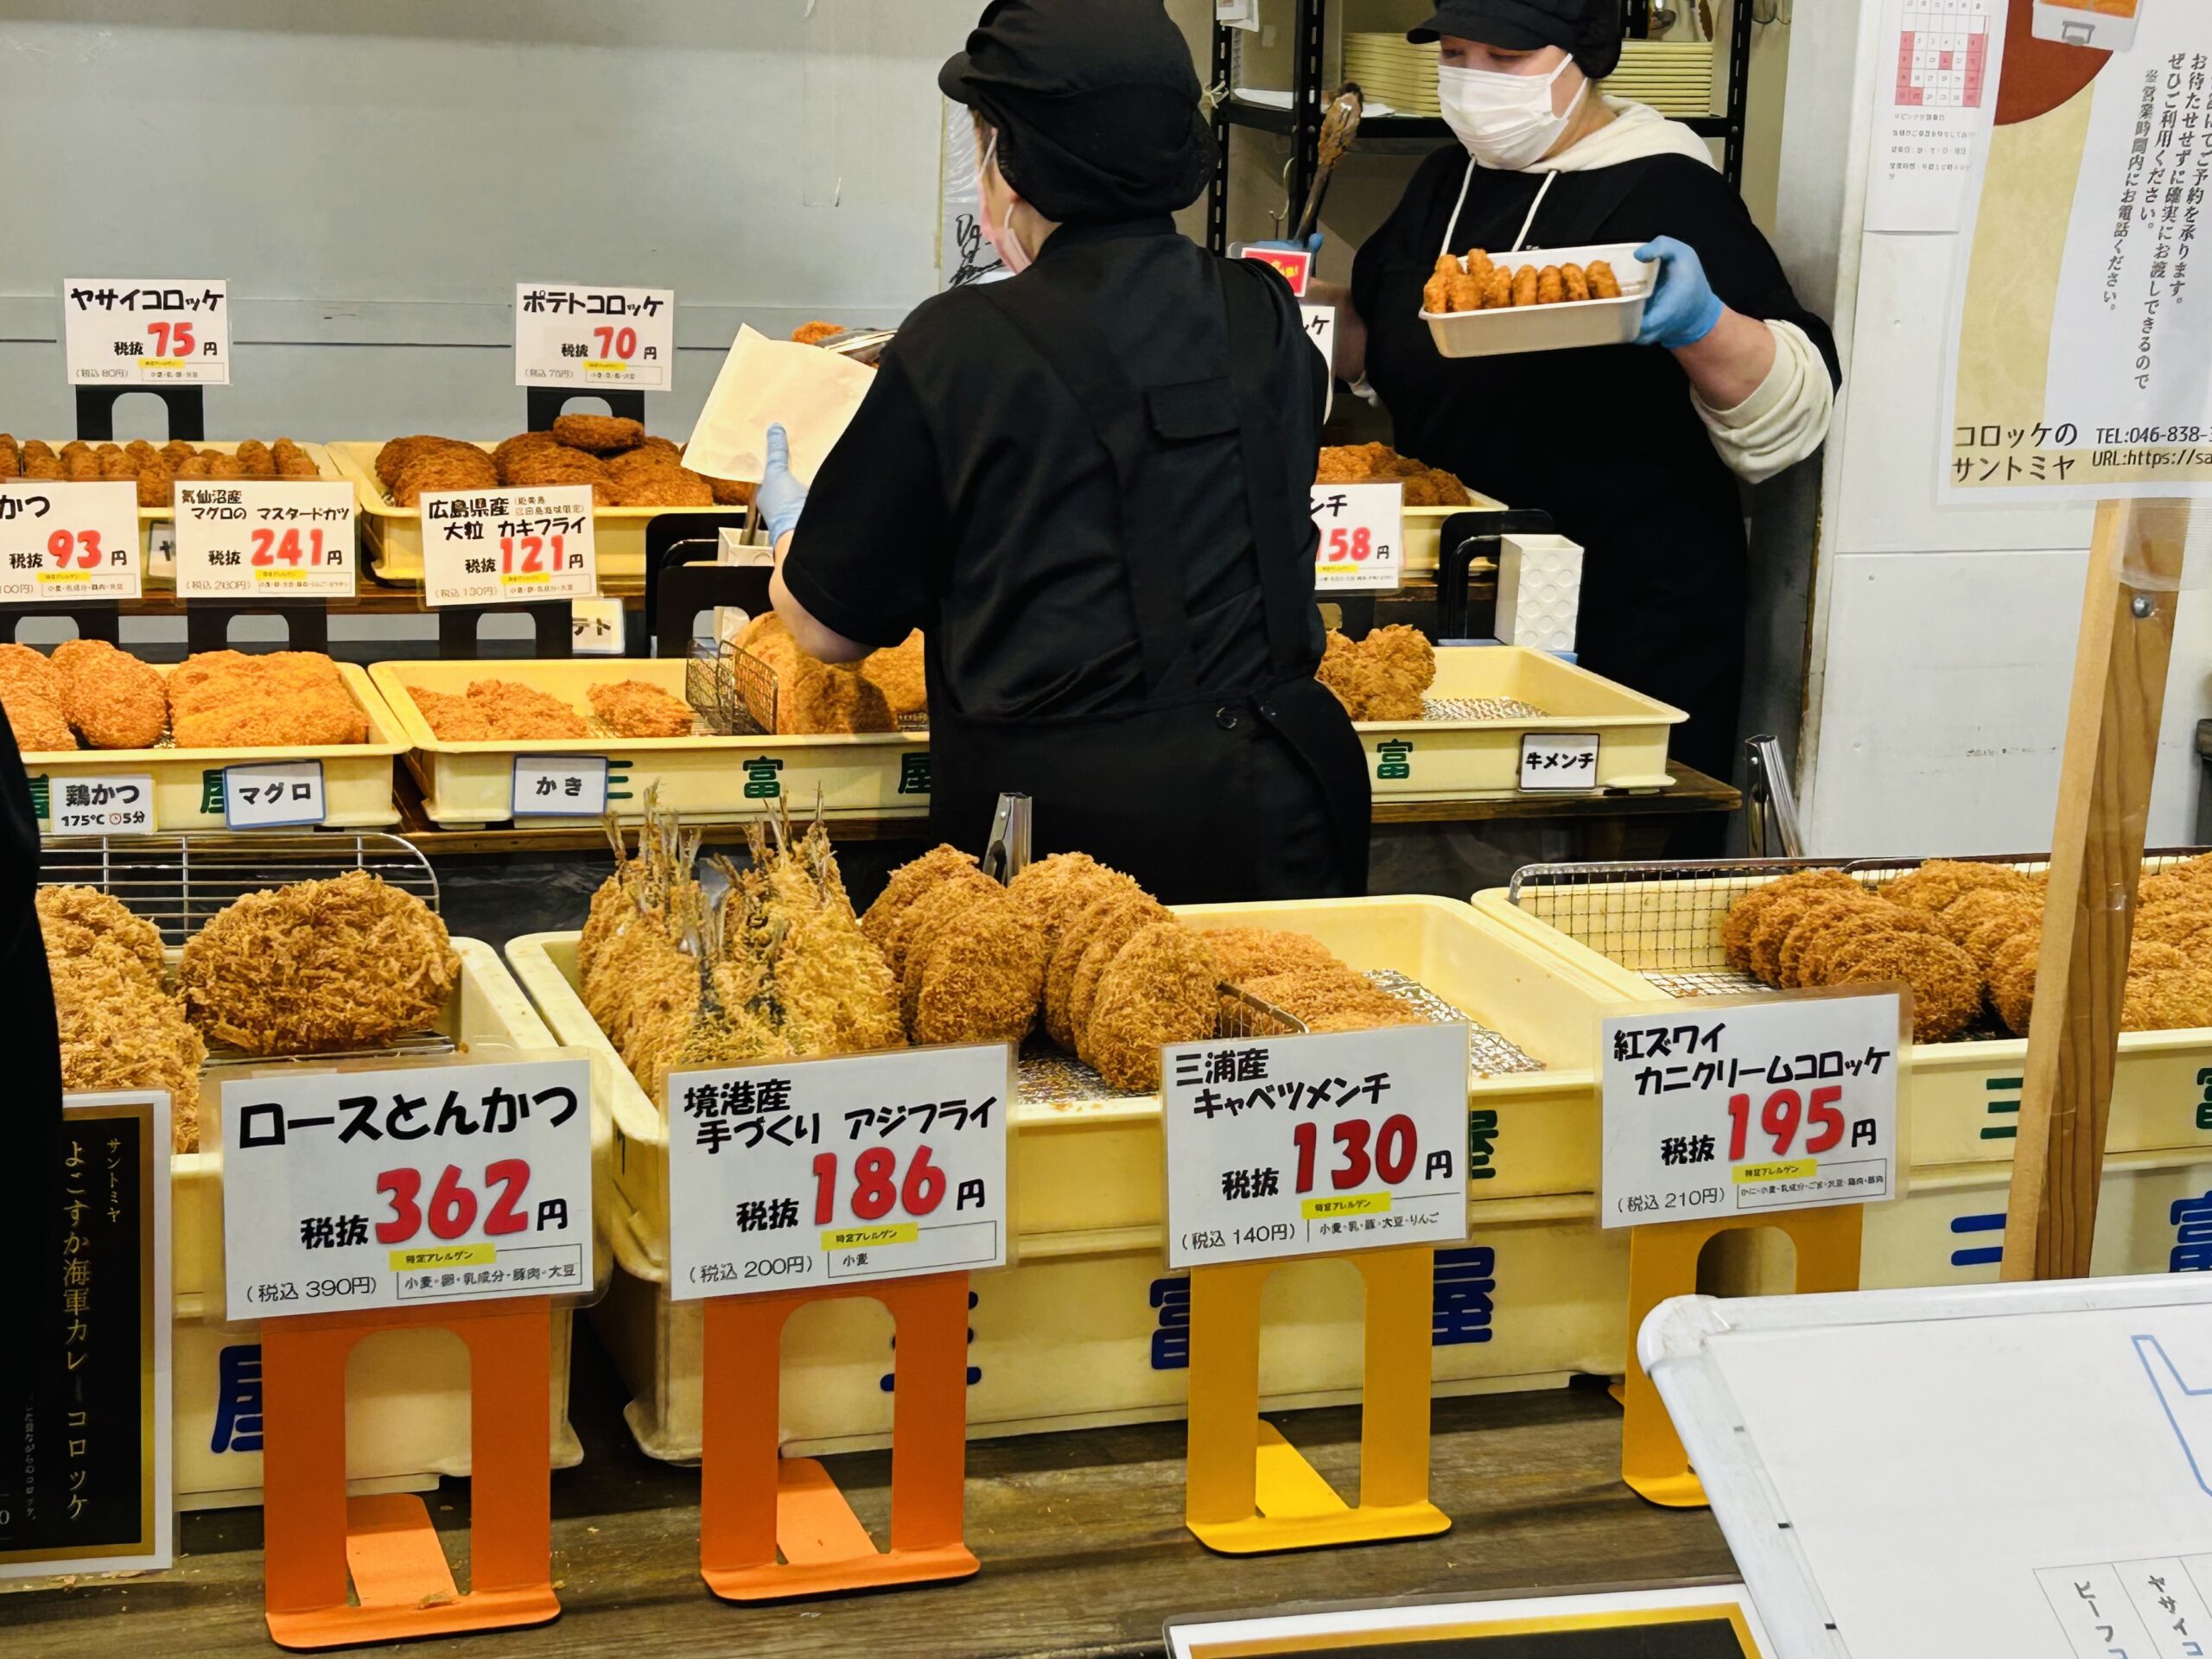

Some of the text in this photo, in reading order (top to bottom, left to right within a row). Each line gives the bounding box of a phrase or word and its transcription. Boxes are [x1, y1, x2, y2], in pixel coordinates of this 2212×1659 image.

[2140, 53, 2185, 229] ぜひご利用ください。
[71, 288, 224, 311] ヤサイコロッケ
[524, 290, 664, 317] ポテトコロッケ
[147, 322, 195, 357] 75
[203, 342, 218, 356] 円
[594, 326, 637, 359] 70
[644, 346, 657, 359] 円
[1955, 423, 2078, 448] コロッケの
[1953, 455, 2075, 482] サントミヤ
[0, 495, 50, 519] かつ
[182, 490, 242, 504] 気仙沼産
[191, 507, 349, 521] マグロの マスタードカツ
[429, 497, 510, 519] 広島県産
[251, 528, 323, 566] 241
[327, 550, 342, 565] 円
[444, 517, 586, 540] 大粒 カキフライ
[1316, 526, 1389, 562] 58 円
[48, 529, 102, 569] 93
[111, 550, 127, 566] 円
[499, 534, 563, 574] 121
[569, 554, 583, 569] 円
[1526, 752, 1594, 771] 牛メンチ
[66, 783, 140, 807] 鶏かつ
[238, 782, 311, 804] マグロ
[537, 777, 582, 797] かき
[1613, 1022, 1726, 1062] 紅ズワイ
[1176, 1047, 1268, 1087] 三浦産
[1635, 1046, 1891, 1096] カニクリームコロッケ
[684, 1078, 791, 1118] 境港産
[1193, 1071, 1391, 1119] キャベツメンチ
[240, 1086, 578, 1149] ロースとんかつ
[696, 1096, 997, 1154] 手づくり アジフライ
[1661, 1084, 1877, 1166] 税抜 195 円
[1222, 1113, 1452, 1201] 税抜 130 円
[107, 1137, 121, 1224] サントミヤ
[736, 1144, 985, 1232] 税抜 186 円
[301, 1159, 568, 1249] 税抜 362 円
[62, 1141, 92, 1521] よこすか海軍カレーコロッケ
